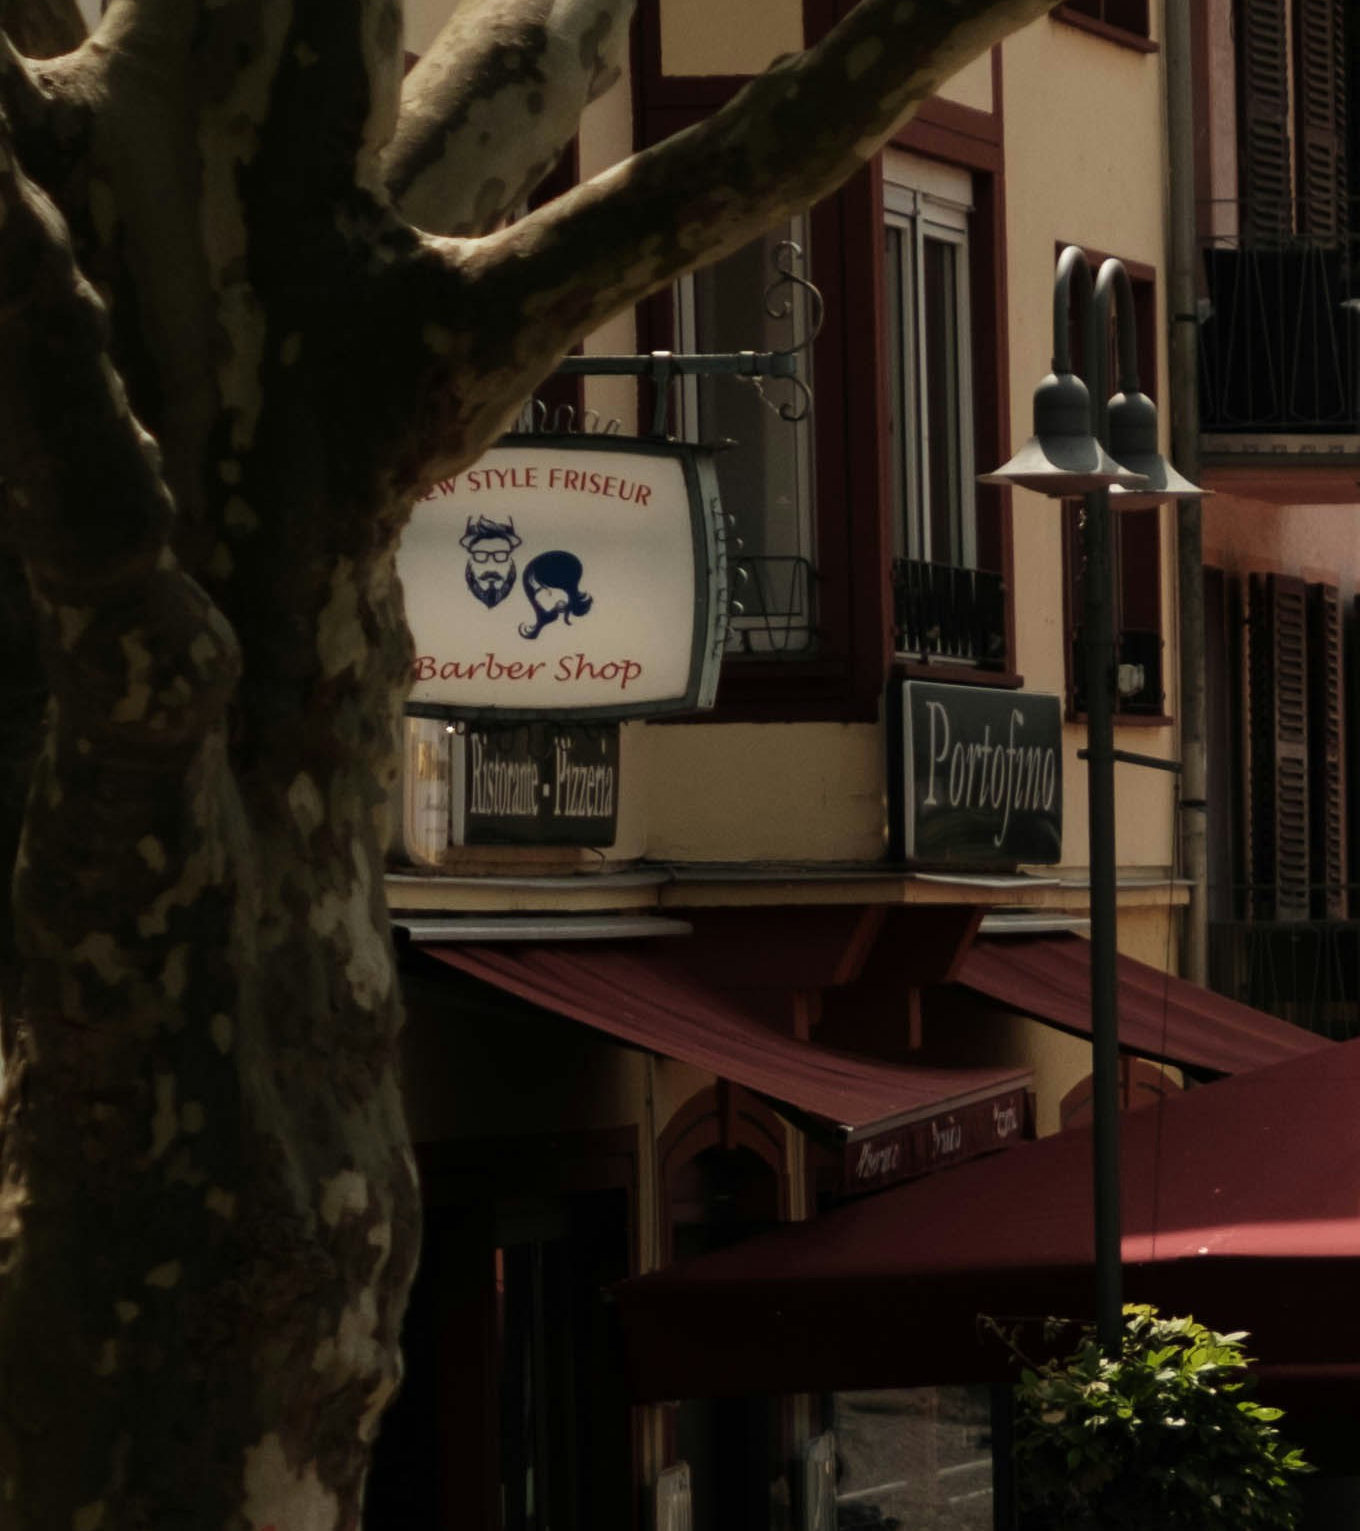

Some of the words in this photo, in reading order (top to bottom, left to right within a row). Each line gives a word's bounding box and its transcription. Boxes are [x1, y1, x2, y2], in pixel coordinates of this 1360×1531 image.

[416, 475, 457, 503] EW
[467, 467, 537, 492] STYLE
[549, 468, 652, 506] FRISEUR
[415, 653, 546, 681] Barber
[554, 653, 642, 690] Shop
[470, 732, 539, 816] Ristorante
[553, 734, 614, 818] Pizzeria
[923, 700, 1056, 847] Portofino
